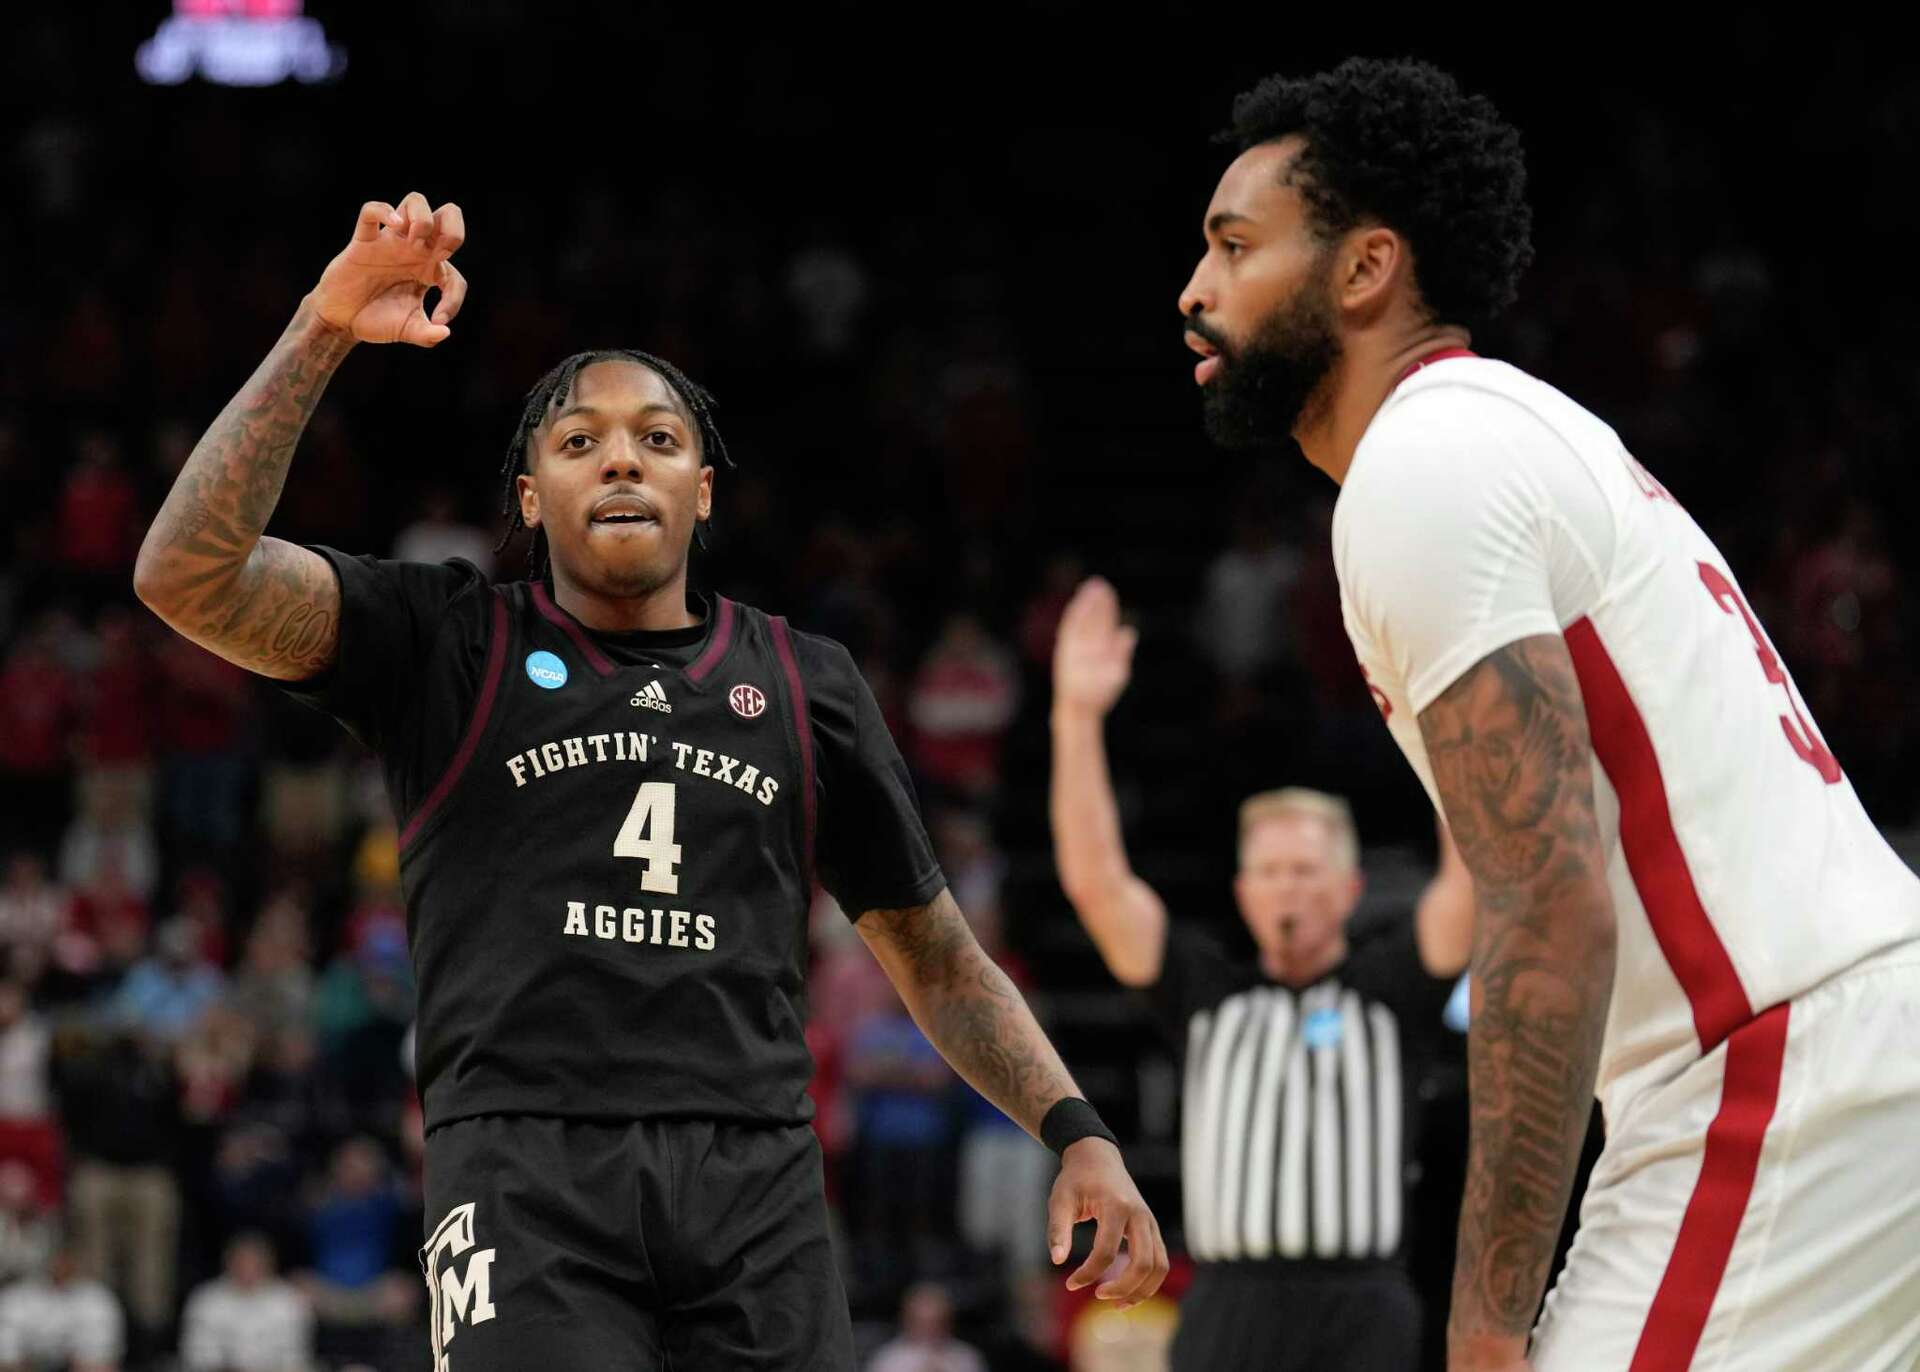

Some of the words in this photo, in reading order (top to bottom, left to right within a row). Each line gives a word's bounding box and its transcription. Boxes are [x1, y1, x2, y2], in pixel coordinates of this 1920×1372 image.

[530, 665, 566, 684] NCAA
[630, 696, 672, 713] adidas
[730, 685, 766, 716] SEC
[506, 732, 657, 787] FIGHTIN'
[672, 741, 779, 806] TEXAS
[613, 782, 682, 895] 4
[563, 901, 716, 951] AGGIES
